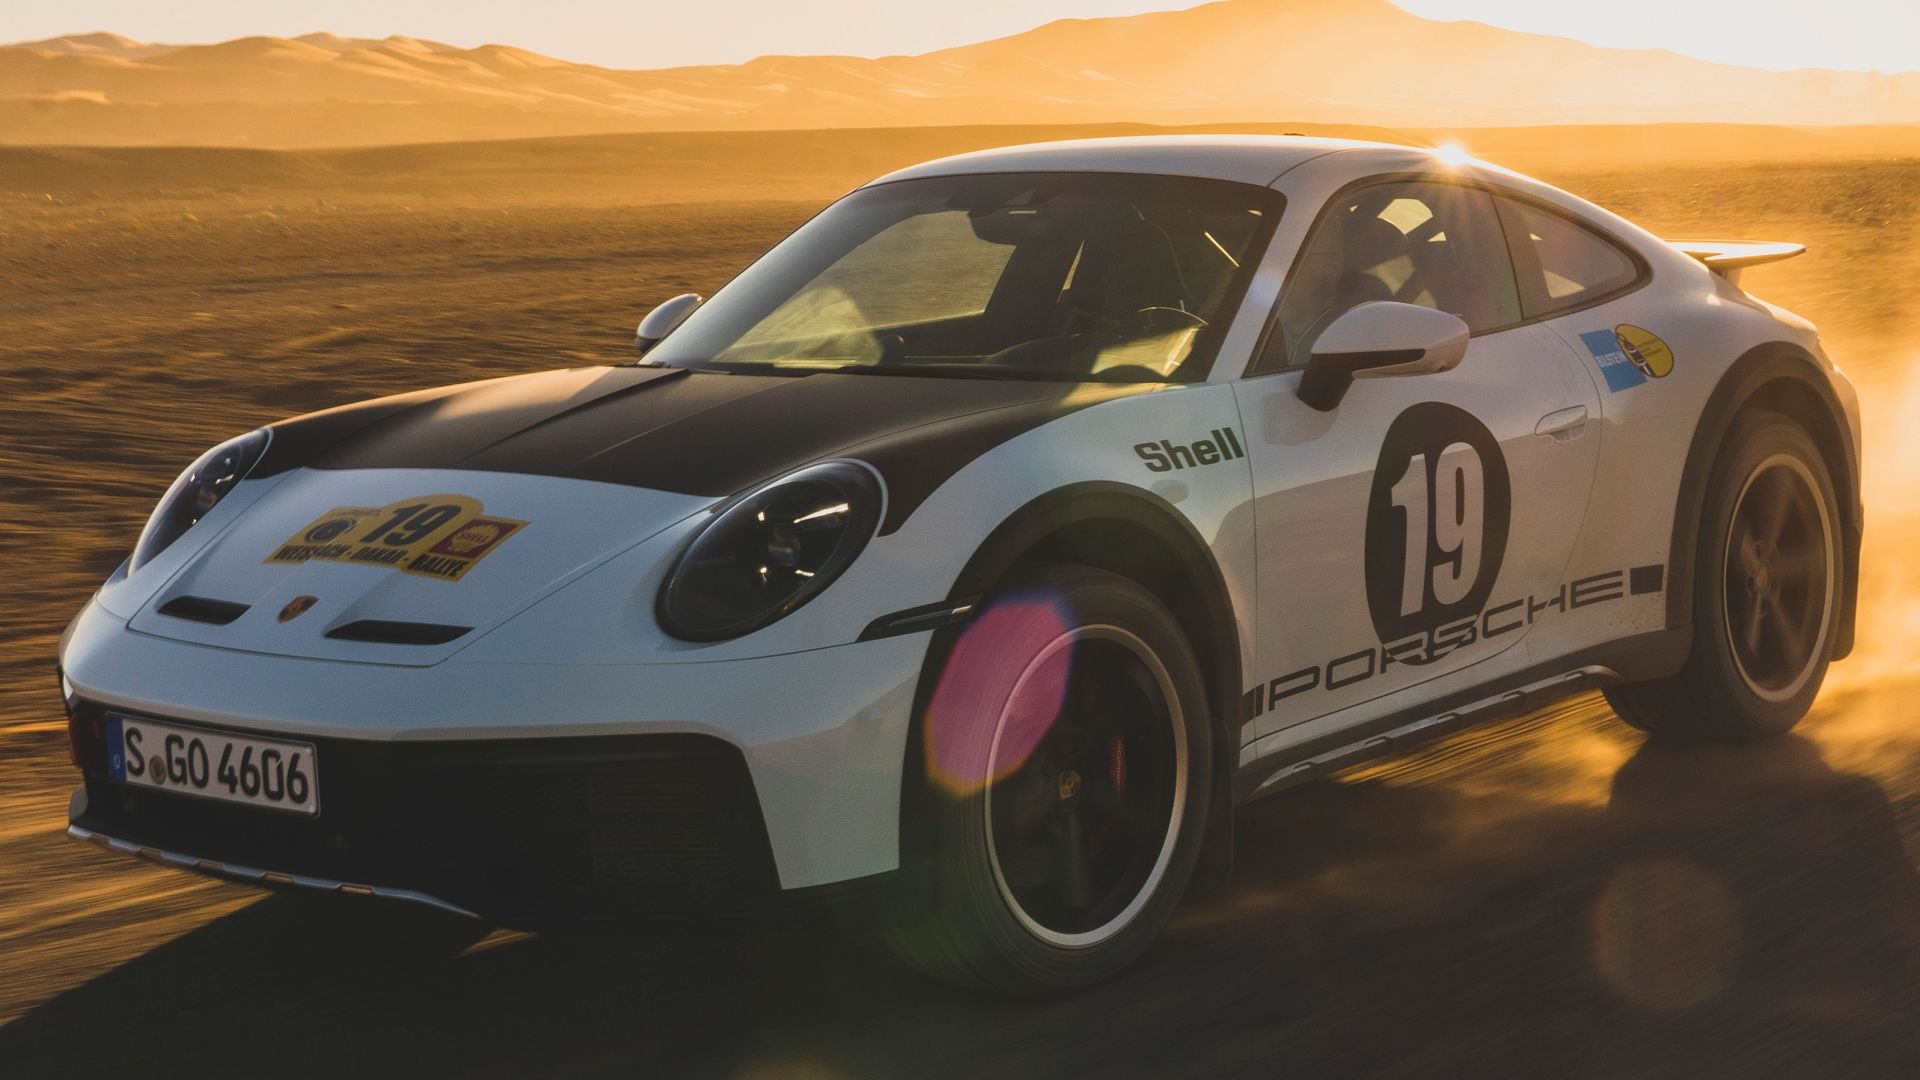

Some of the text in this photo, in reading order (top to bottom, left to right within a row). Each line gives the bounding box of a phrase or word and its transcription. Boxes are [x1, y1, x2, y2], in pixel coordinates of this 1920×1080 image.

[1133, 427, 1245, 473] Shell
[359, 503, 463, 547] 19
[1391, 441, 1485, 618] 19
[1268, 570, 1623, 712] PORSCHE
[125, 726, 309, 804] S GO 4606
